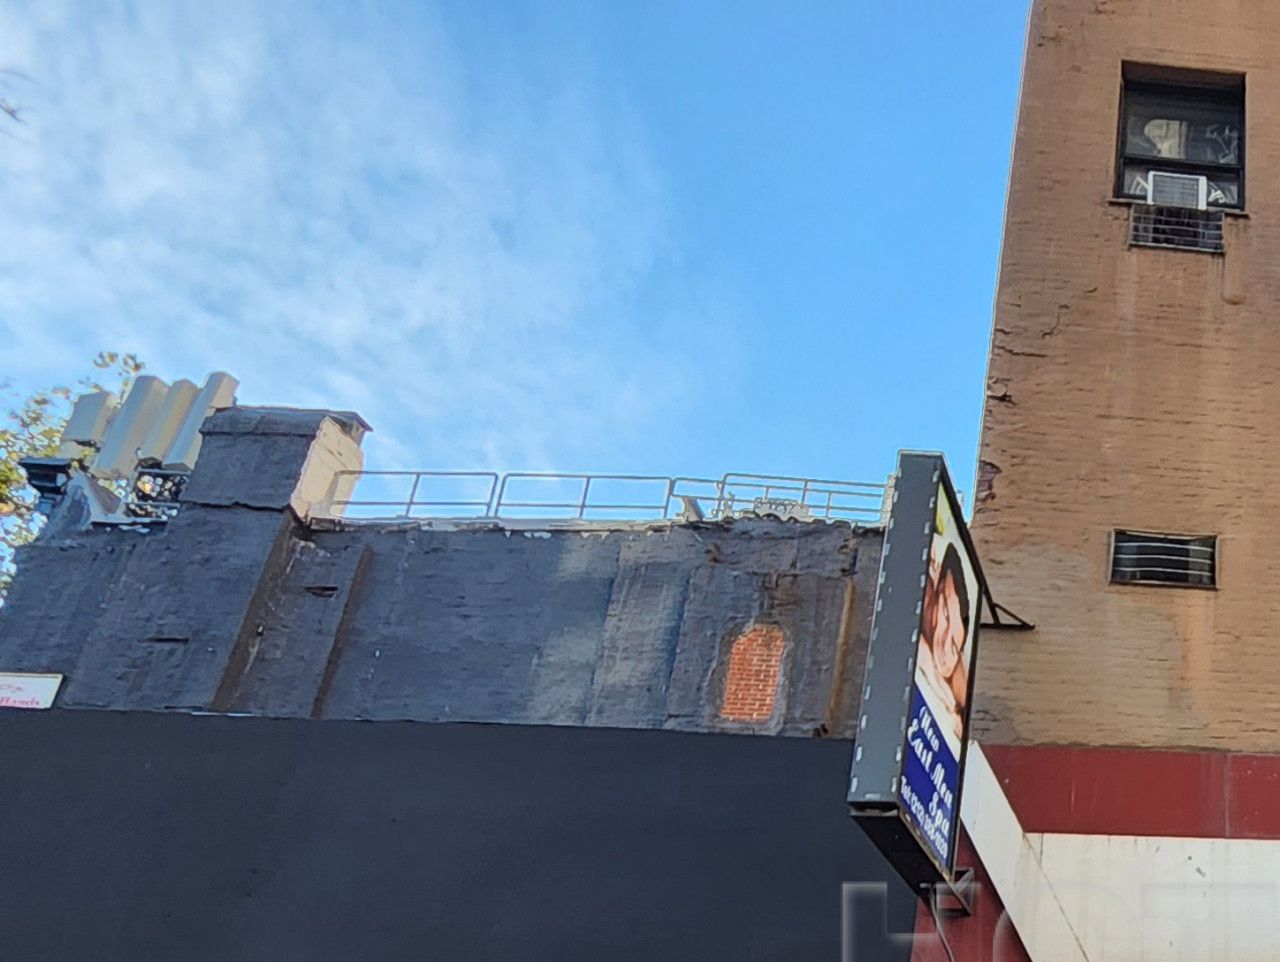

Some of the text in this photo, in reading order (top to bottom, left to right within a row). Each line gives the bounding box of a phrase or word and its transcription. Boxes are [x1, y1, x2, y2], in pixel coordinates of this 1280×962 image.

[919, 706, 940, 752] New
[907, 717, 953, 808] East Men
[928, 791, 950, 837] Spa
